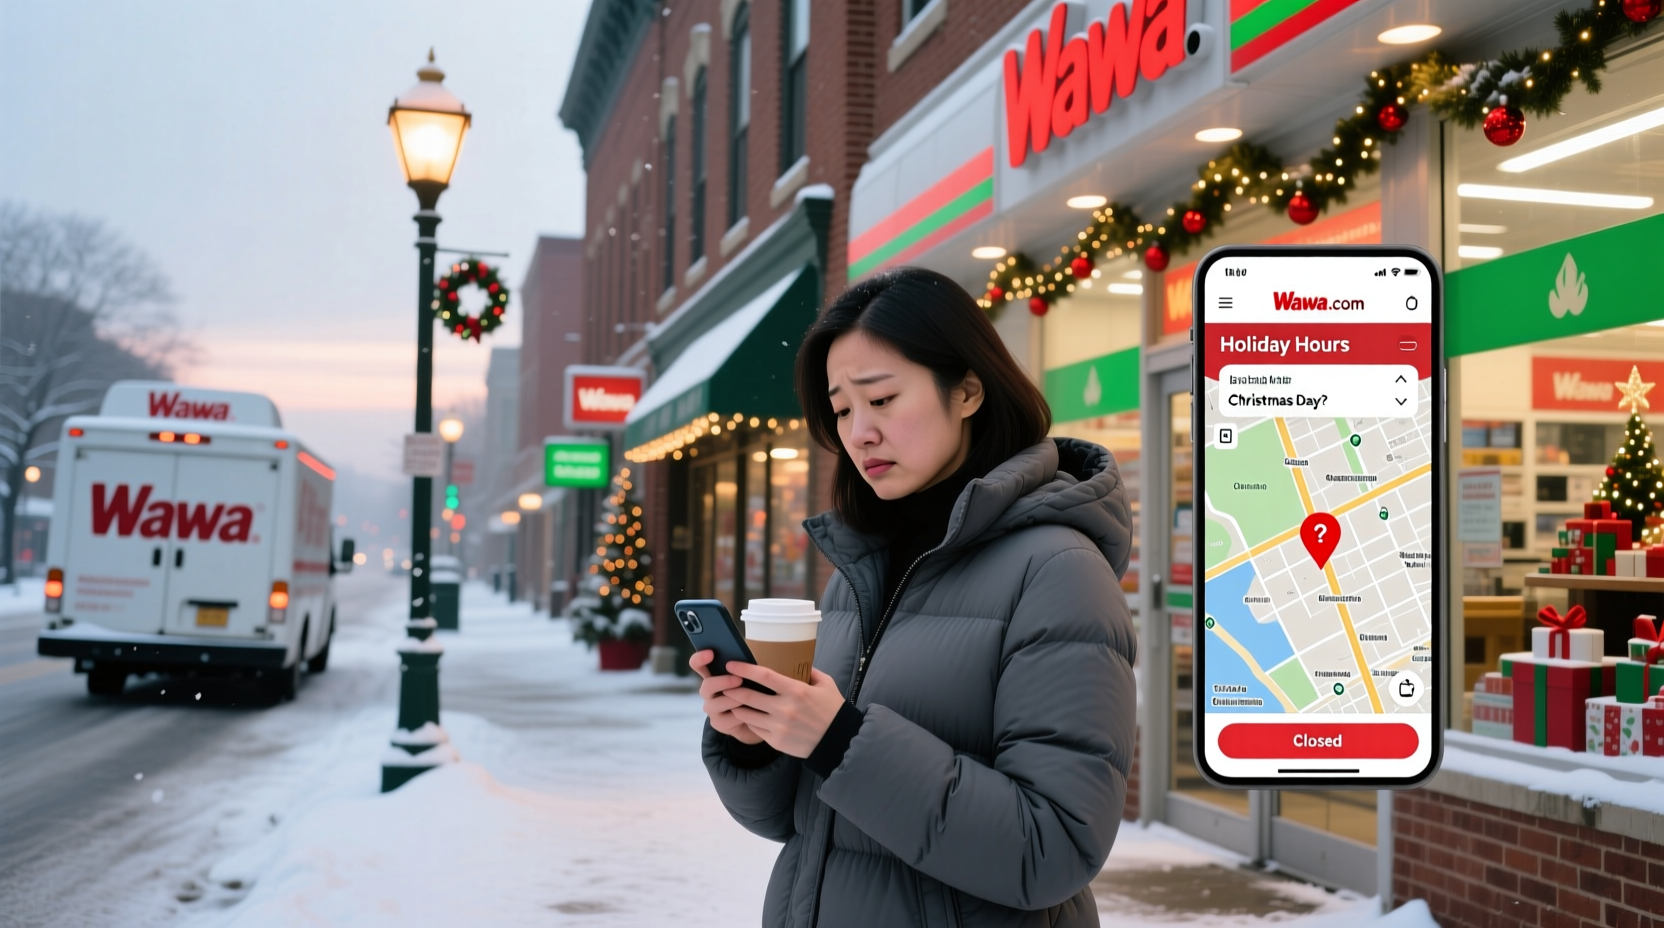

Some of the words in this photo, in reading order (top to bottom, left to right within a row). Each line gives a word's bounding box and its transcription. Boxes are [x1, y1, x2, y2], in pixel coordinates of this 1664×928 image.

[1003, 0, 1187, 168] Wawa
[1273, 291, 1365, 311] Wawa.com
[1220, 335, 1290, 357] Holiday
[1295, 335, 1350, 353] Hours
[148, 391, 230, 421] Wawa
[1228, 393, 1293, 407] Christmas
[1296, 394, 1328, 410] Day?
[91, 482, 254, 543] Wawa
[1313, 523, 1327, 544] ?
[1293, 733, 1343, 749] Closed
